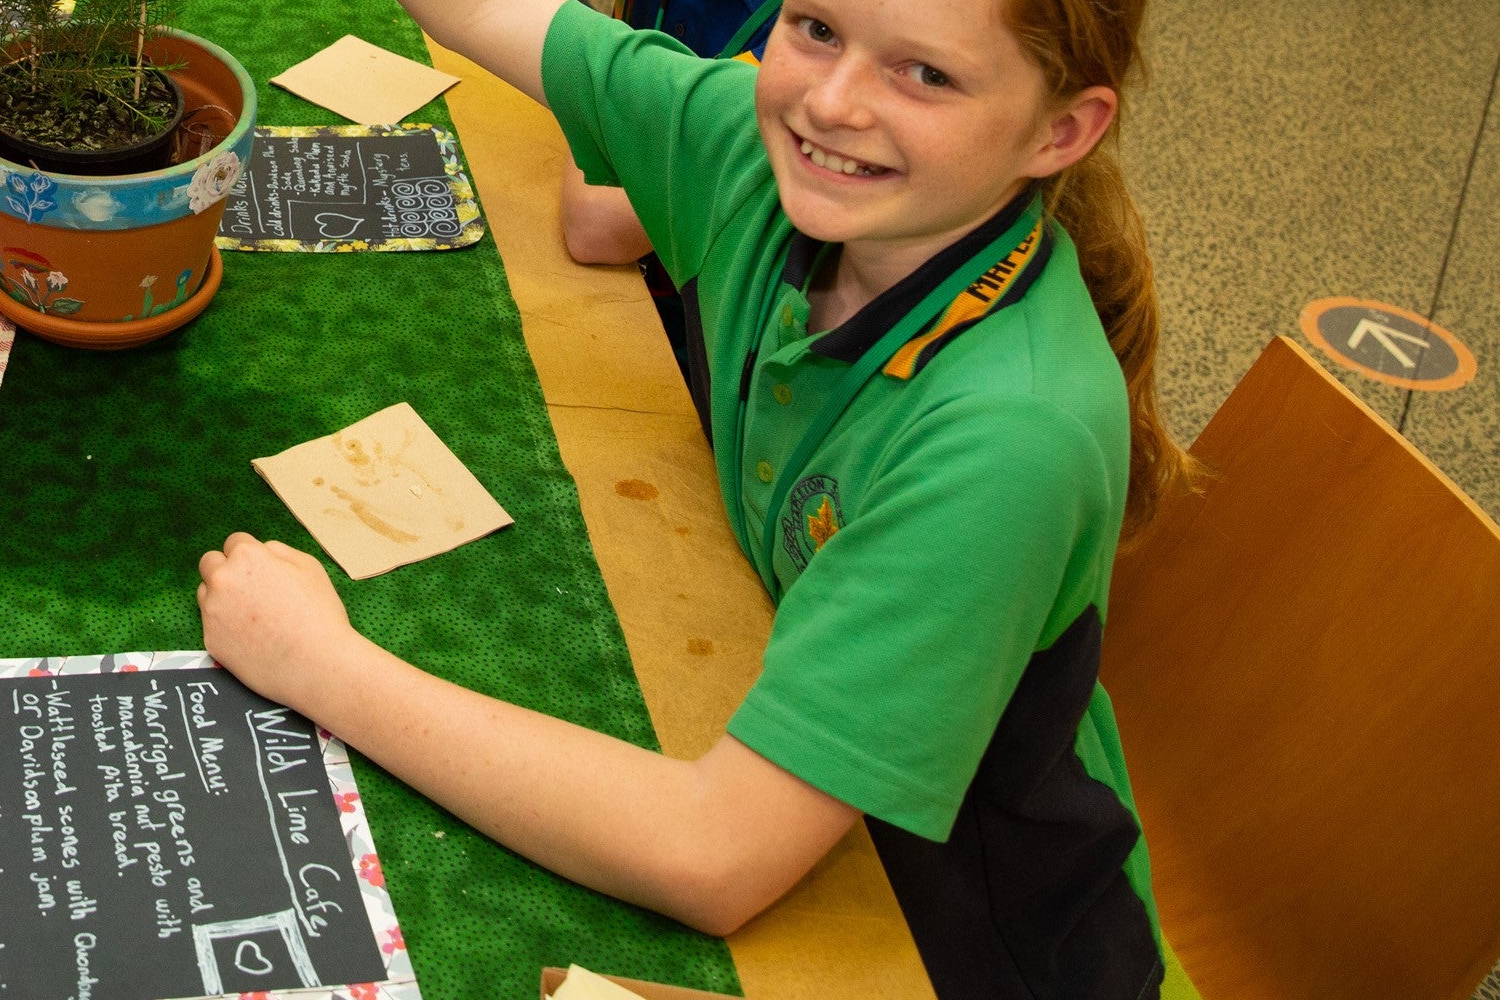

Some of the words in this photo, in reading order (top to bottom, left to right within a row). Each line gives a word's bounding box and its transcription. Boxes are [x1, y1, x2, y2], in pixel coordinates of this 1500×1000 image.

[226, 201, 253, 235] Drinks
[381, 224, 401, 237] Hot
[17, 692, 43, 719] or
[88, 694, 117, 753] toasted
[187, 681, 218, 729] Food
[116, 695, 150, 798] macadamia
[253, 707, 311, 773] Wild
[19, 725, 46, 811] Davidson
[21, 814, 54, 863] plum
[58, 804, 81, 869] scones
[134, 803, 167, 832] nut
[277, 788, 319, 845] Lime
[133, 841, 172, 888] pesto
[153, 788, 195, 868] greens
[187, 877, 215, 914] and
[66, 879, 98, 921] with
[155, 898, 183, 938] with
